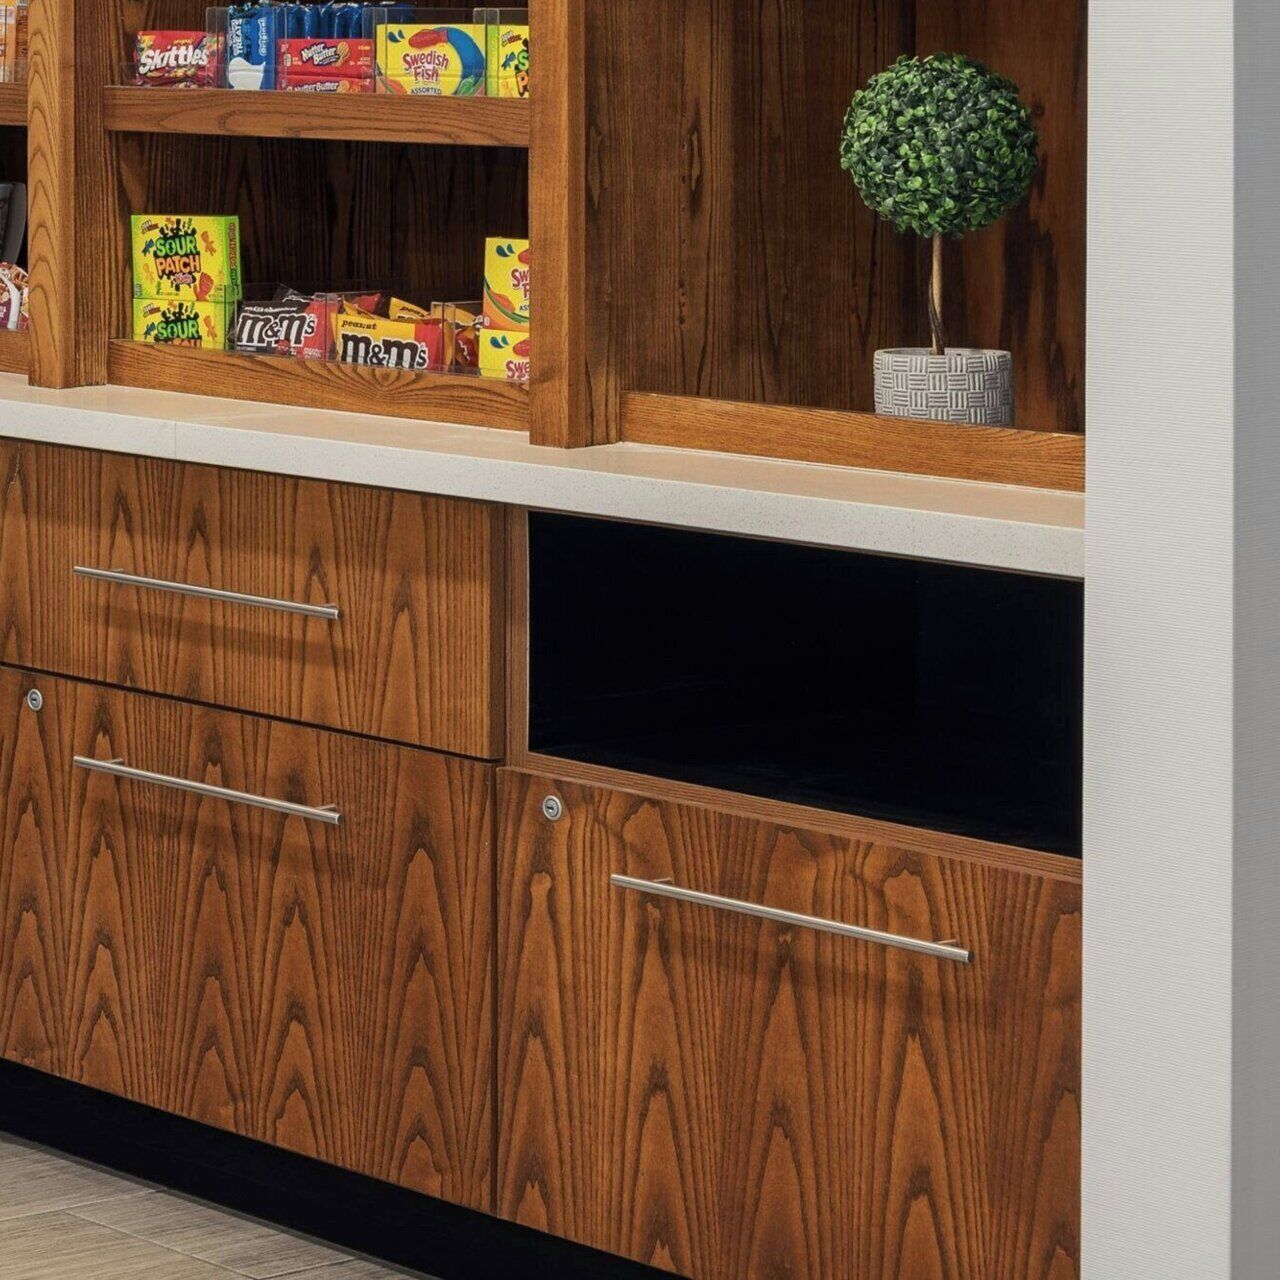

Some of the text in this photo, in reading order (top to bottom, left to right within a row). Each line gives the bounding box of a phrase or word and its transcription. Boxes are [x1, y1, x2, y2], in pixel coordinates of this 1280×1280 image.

[139, 45, 210, 75] Skittles
[301, 42, 325, 62] Nutter
[313, 47, 338, 65] Butter
[402, 51, 450, 72] Swedish
[414, 66, 439, 81] Fish
[156, 236, 197, 256] SOUR
[155, 254, 200, 276] PATCH
[157, 320, 198, 339] SOUR
[238, 313, 317, 347] m&m's
[341, 319, 377, 330] peanut
[341, 332, 428, 369] m&m's
